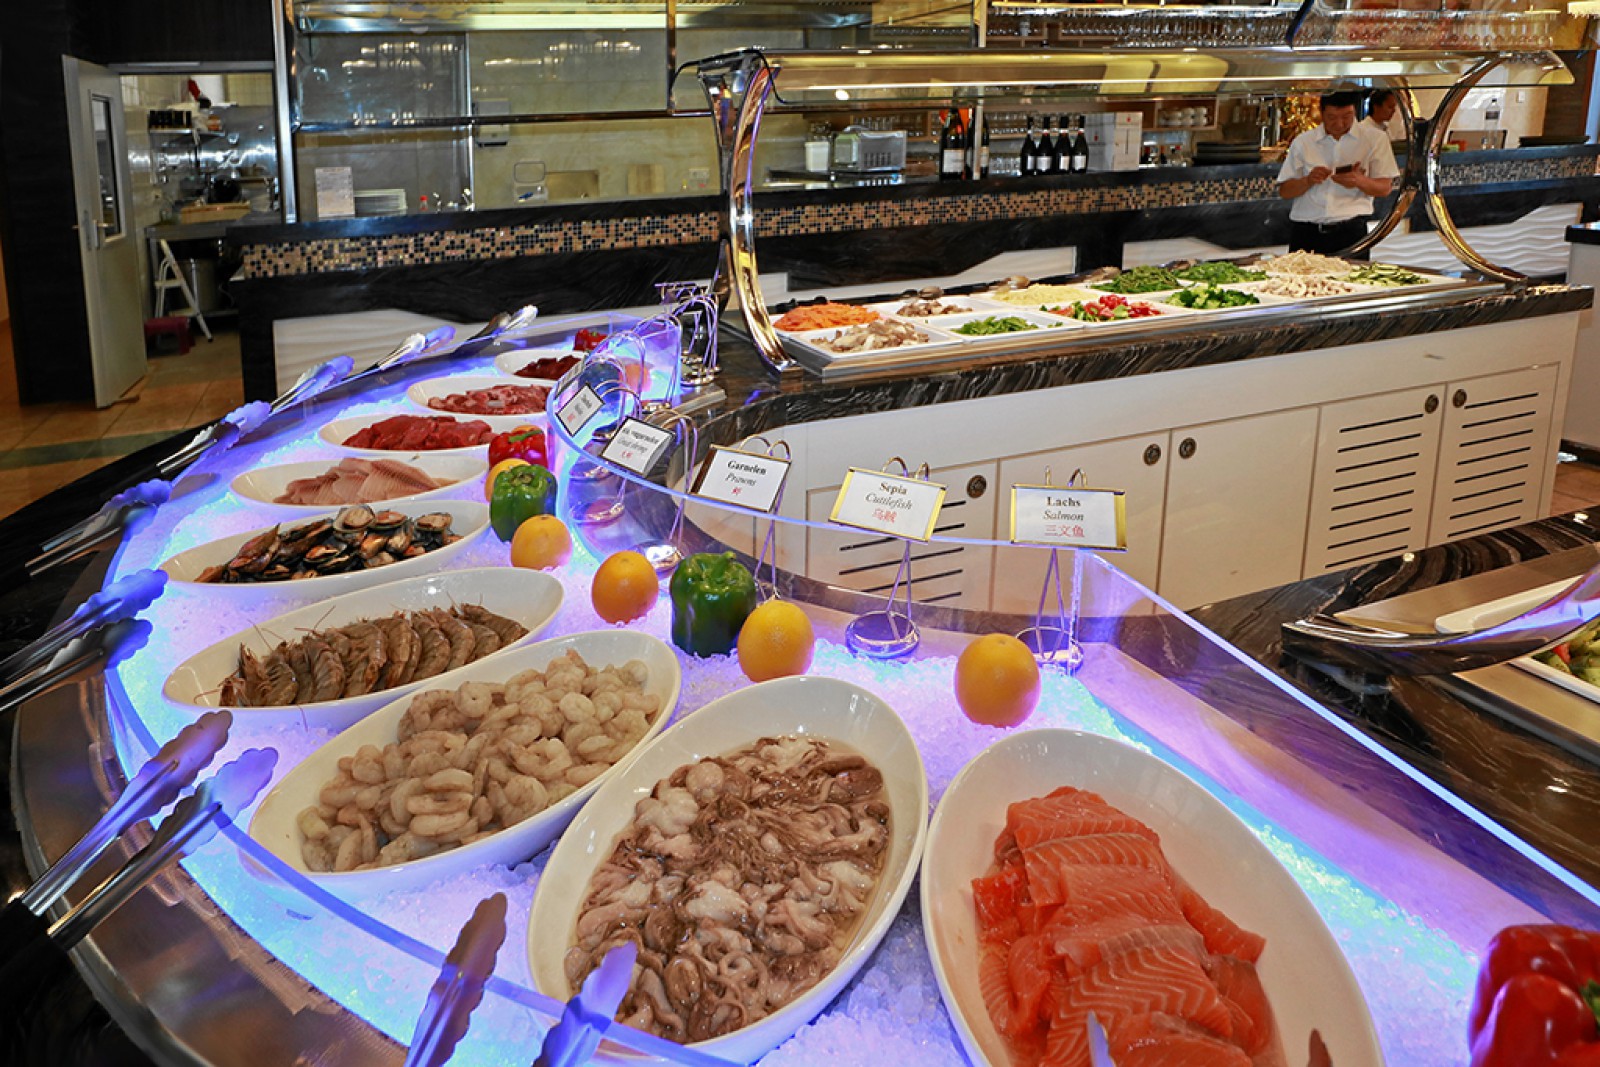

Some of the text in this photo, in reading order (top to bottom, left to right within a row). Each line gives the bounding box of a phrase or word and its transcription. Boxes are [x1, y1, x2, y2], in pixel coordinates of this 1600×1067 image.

[727, 460, 767, 475] Garnelen
[725, 473, 757, 487] Prawns
[879, 481, 908, 495] Sepia
[865, 492, 913, 510] Cuttlefish
[1046, 496, 1082, 507] Lachs
[1043, 509, 1085, 521] Salmon
[1044, 524, 1086, 538] 三文鱼
